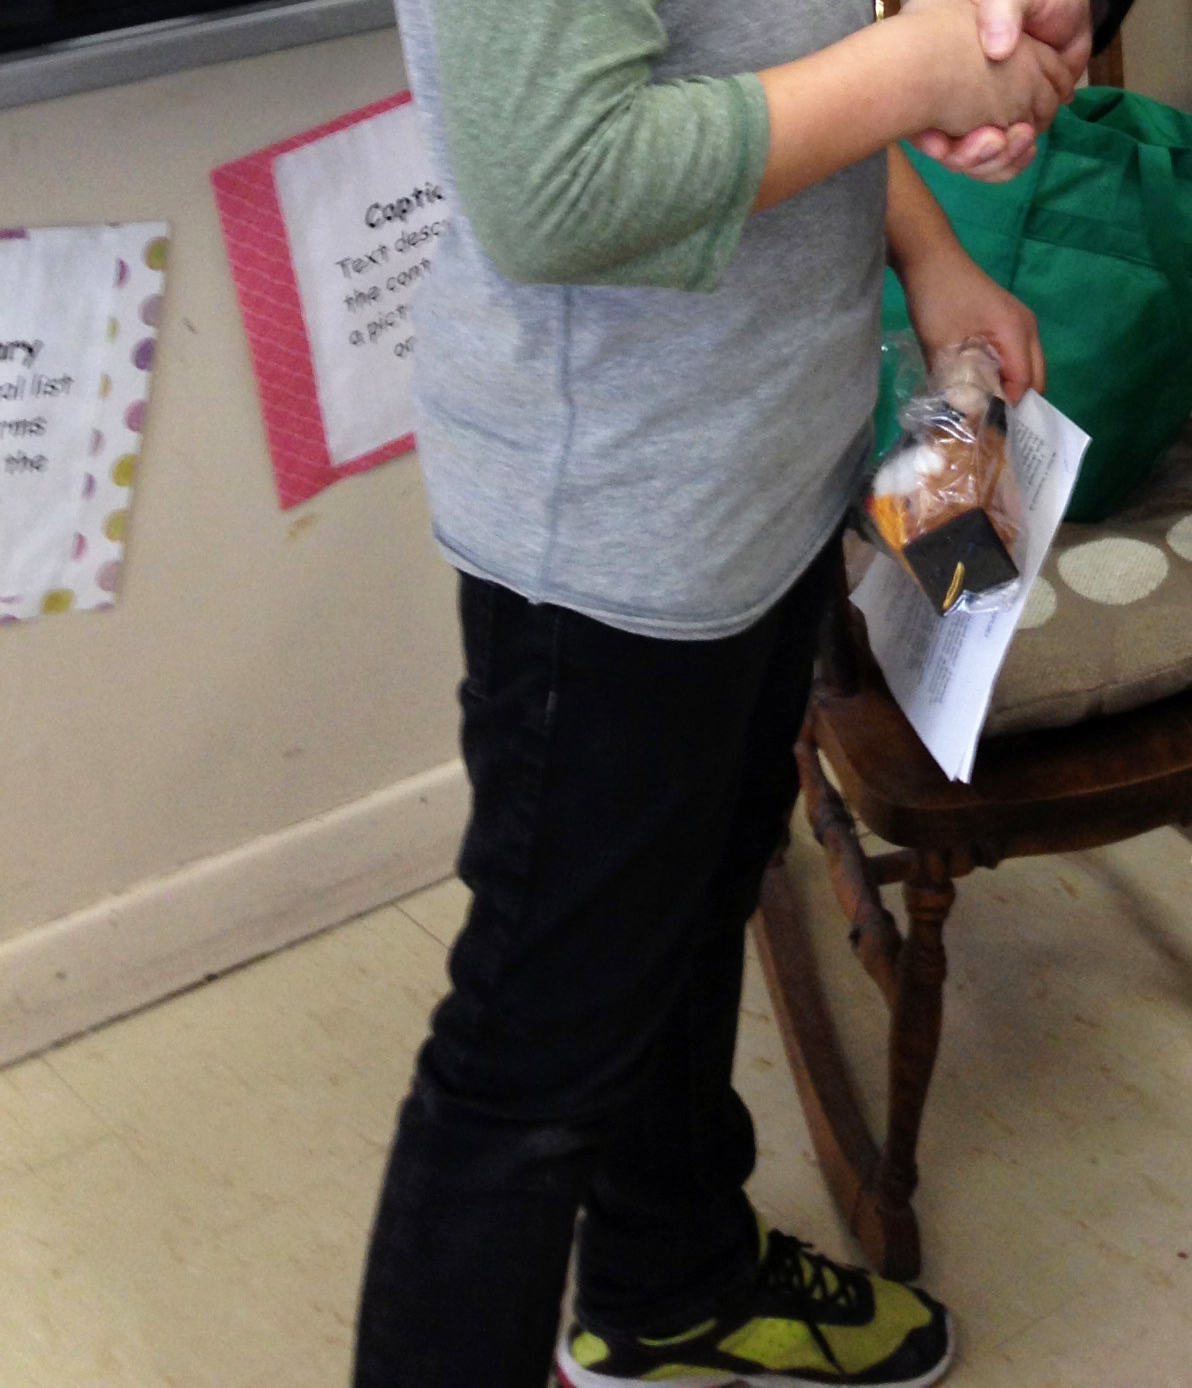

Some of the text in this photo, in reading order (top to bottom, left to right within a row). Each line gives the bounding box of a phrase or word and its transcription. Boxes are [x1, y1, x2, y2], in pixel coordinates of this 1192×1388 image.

[334, 245, 389, 281] Text
[343, 258, 431, 314] the cont
[348, 304, 409, 347] a pict
[30, 372, 75, 399] list
[4, 449, 49, 475] the
